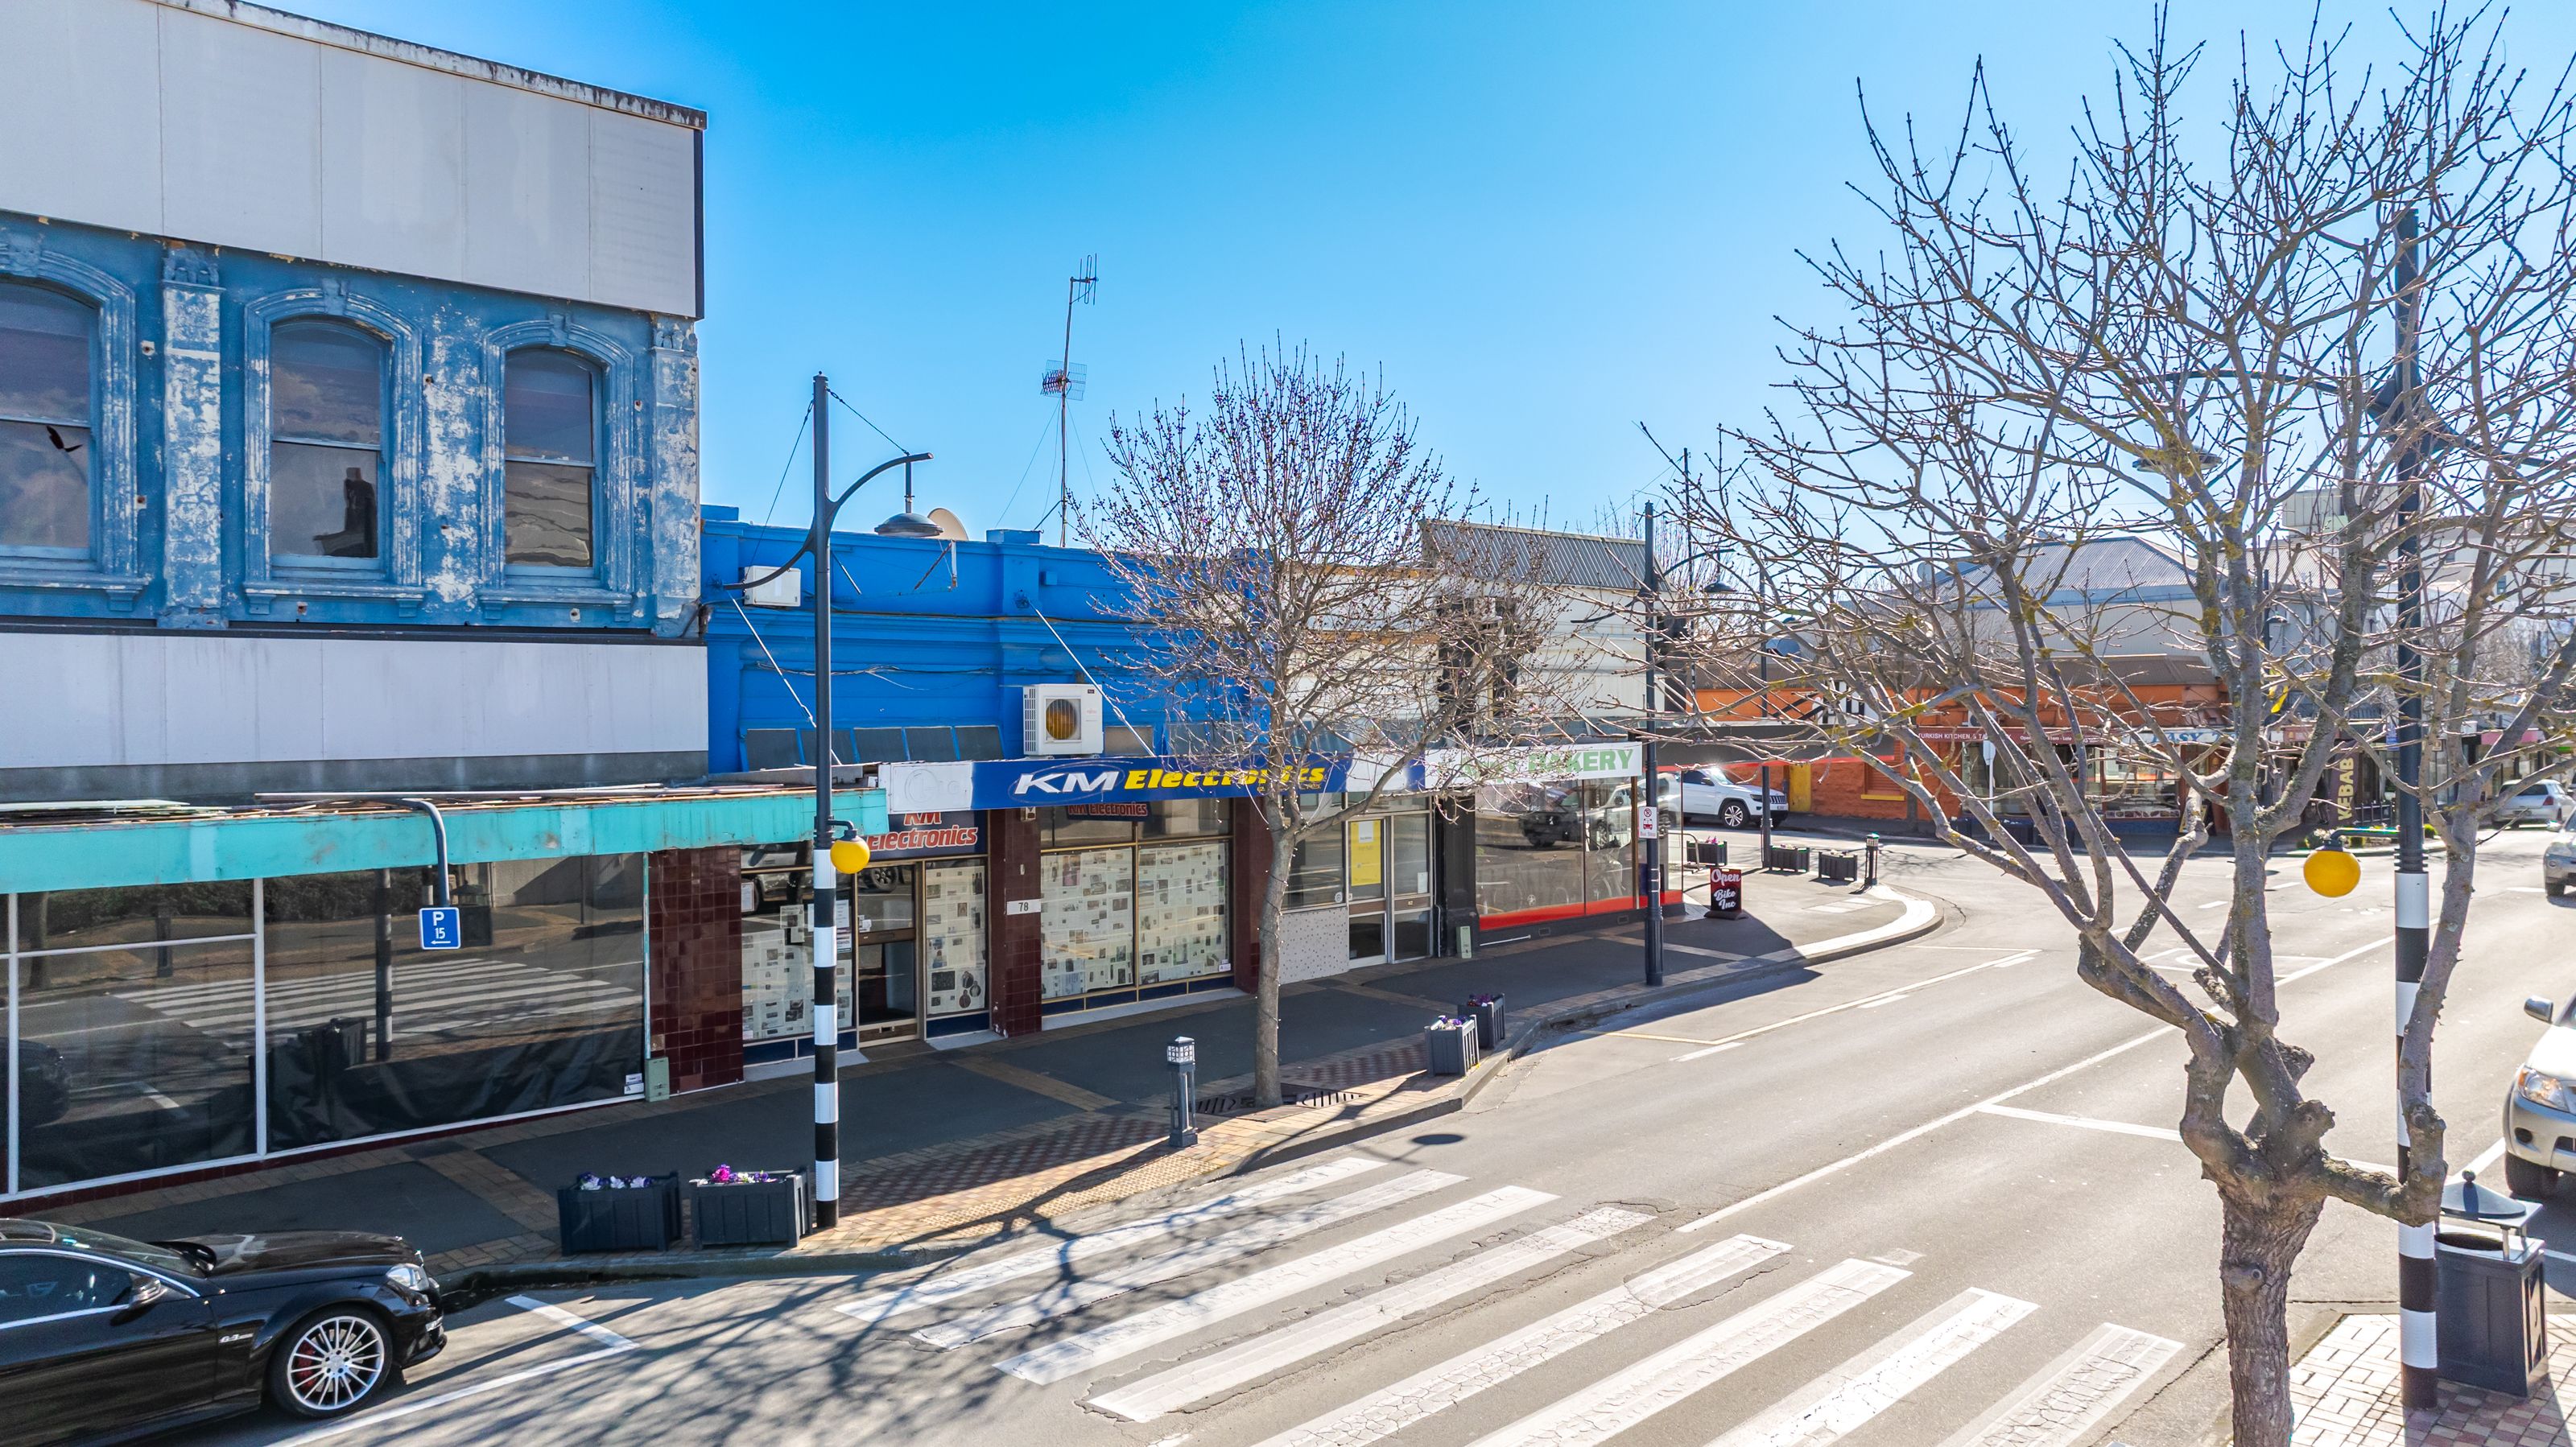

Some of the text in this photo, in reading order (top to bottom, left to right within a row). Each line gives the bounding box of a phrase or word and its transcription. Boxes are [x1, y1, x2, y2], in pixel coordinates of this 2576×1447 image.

[2151, 732, 2204, 744] ASY
[1528, 749, 1634, 773] BAKERY
[1013, 770, 1120, 795] KM
[2337, 756, 2355, 821] KEBAB
[1068, 802, 1148, 817] KM Electronics
[903, 811, 942, 826] KM
[866, 824, 979, 851] Electronics
[1711, 868, 1741, 886] Open
[1713, 888, 1736, 901] Bike
[1018, 901, 1029, 912] 78
[1718, 898, 1736, 910] Inc
[432, 911, 445, 926] P
[435, 927, 446, 940] 15
